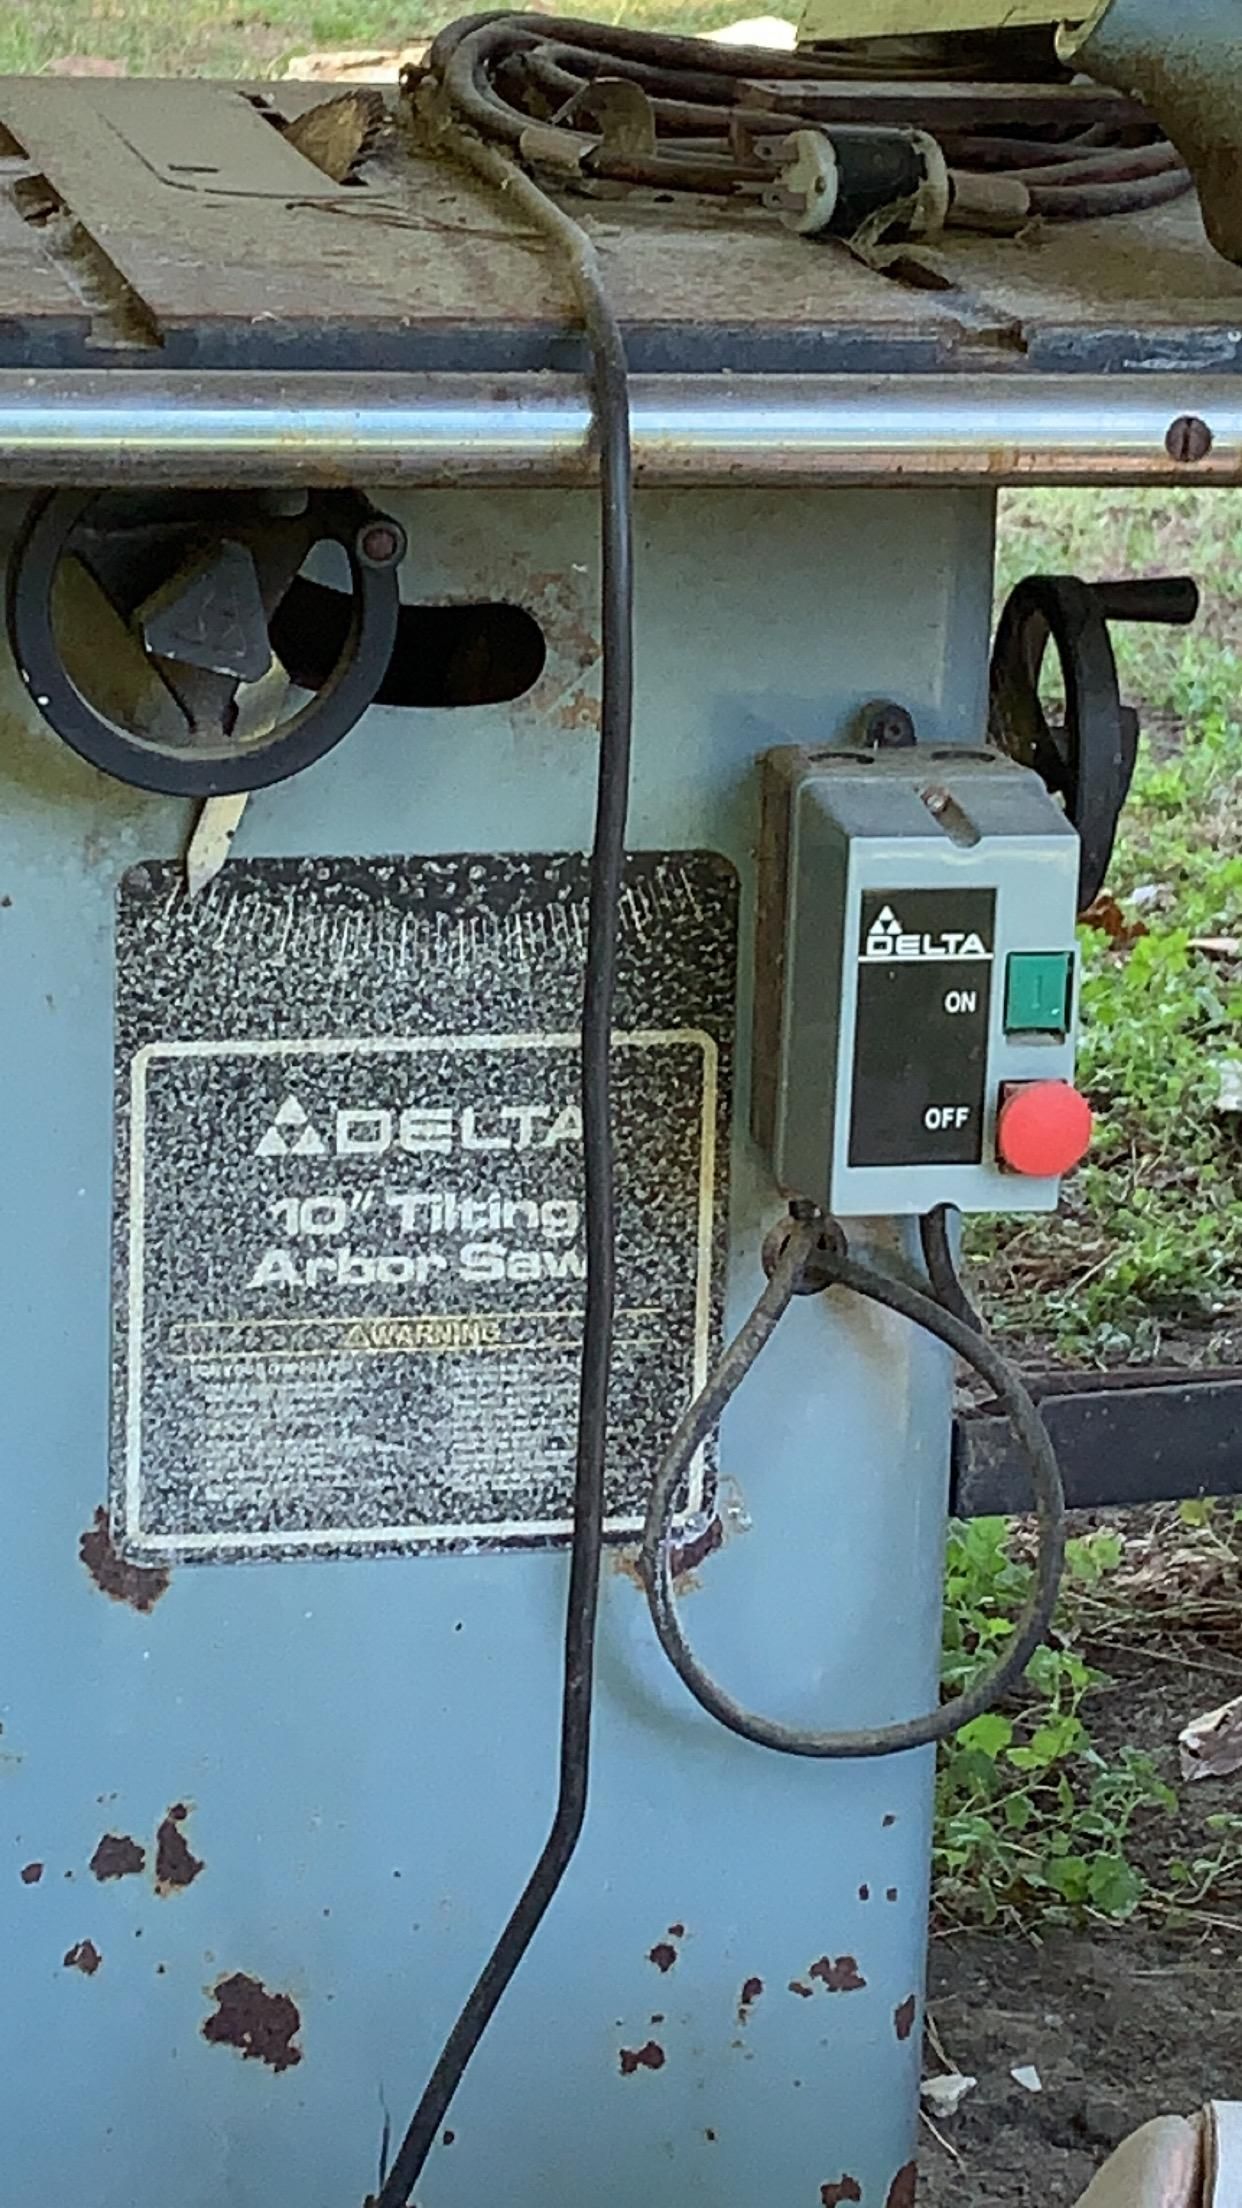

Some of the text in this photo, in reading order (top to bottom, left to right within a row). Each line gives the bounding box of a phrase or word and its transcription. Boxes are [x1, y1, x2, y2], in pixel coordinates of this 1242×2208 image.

[867, 933, 985, 956] DELTA
[944, 991, 976, 1013] ON
[336, 1105, 584, 1154] DELTA
[924, 1107, 969, 1129] OFF
[386, 1192, 579, 1238] Tilting
[247, 1242, 587, 1290] Arbor Saw
[372, 1322, 500, 1346] WARNING
